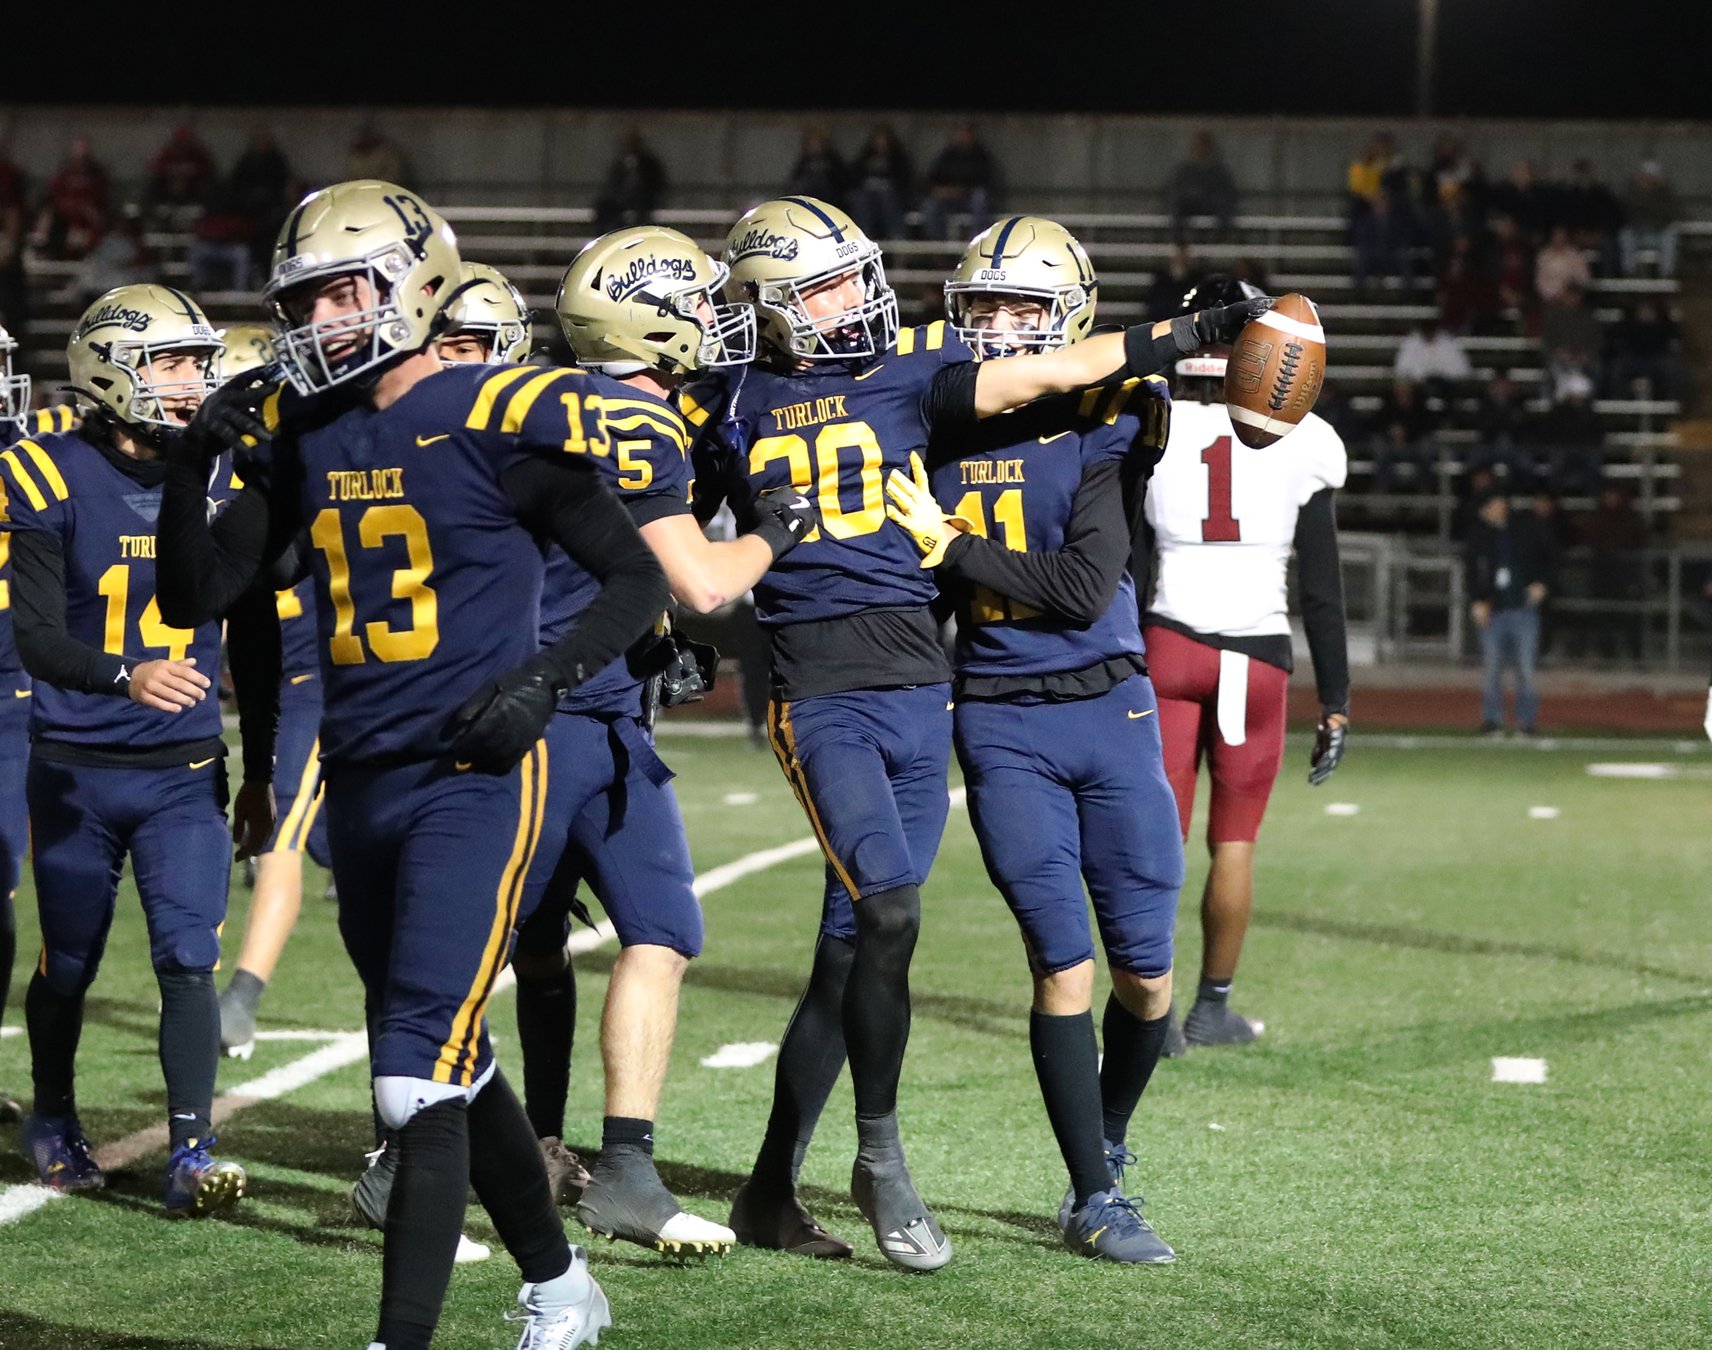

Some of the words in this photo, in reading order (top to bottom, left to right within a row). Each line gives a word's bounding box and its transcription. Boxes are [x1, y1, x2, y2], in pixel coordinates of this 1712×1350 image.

[383, 195, 433, 236] 13
[836, 241, 860, 259] DOGS
[606, 253, 697, 302] Bulldogs
[980, 269, 1007, 281] DOGS
[560, 392, 611, 458] 13
[771, 394, 848, 431] TURLOCK
[327, 467, 404, 501] TURLOCK
[617, 439, 653, 490] 5
[959, 459, 1026, 485] TURLOCK
[1201, 435, 1241, 542] 1
[311, 504, 440, 666] 13
[98, 564, 195, 662] 14
